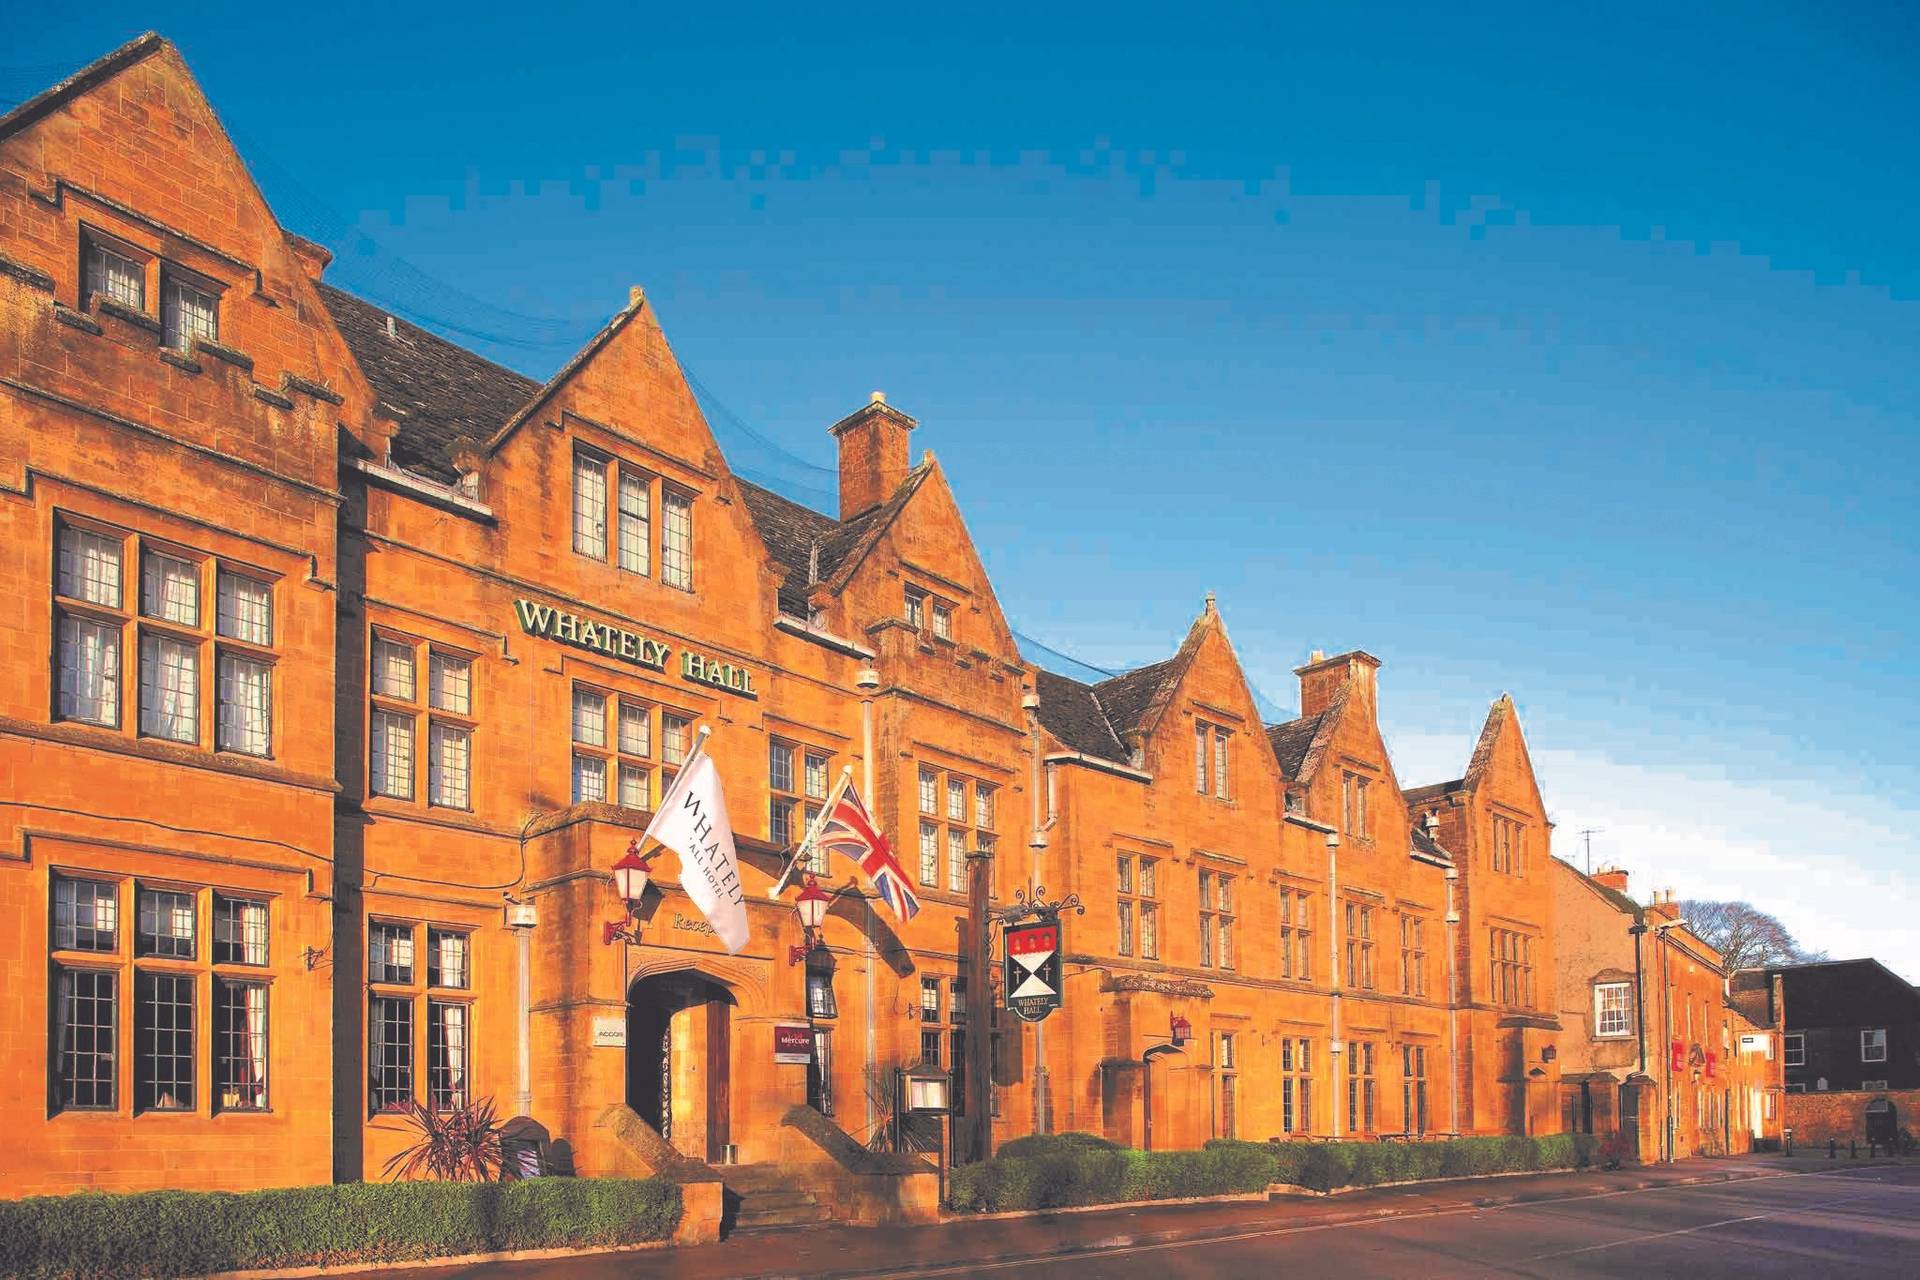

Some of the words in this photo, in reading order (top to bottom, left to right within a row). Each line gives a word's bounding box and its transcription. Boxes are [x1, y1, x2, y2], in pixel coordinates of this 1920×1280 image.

[515, 599, 670, 673] WHATELY
[682, 649, 757, 699] HALL
[688, 836, 703, 866] ALL
[702, 866, 726, 899] HOTEL
[672, 911, 718, 938] Recep
[1018, 997, 1049, 1007] WHATELY
[1023, 1005, 1042, 1015] HALL
[781, 1037, 810, 1045] Mercure
